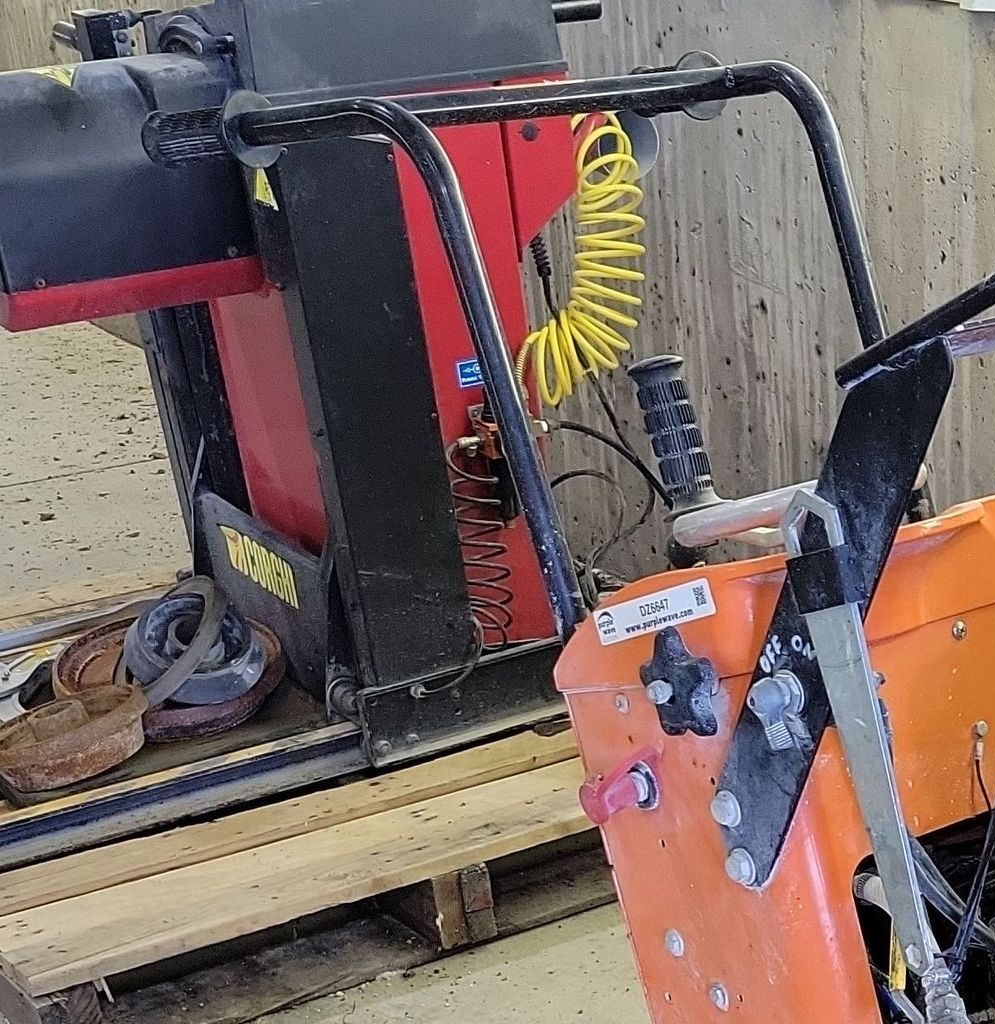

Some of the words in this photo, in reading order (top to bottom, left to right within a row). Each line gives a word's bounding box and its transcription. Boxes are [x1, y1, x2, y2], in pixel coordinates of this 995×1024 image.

[243, 534, 300, 610] CORGHI
[638, 598, 669, 617] DZ6647
[602, 626, 617, 636] wave
[624, 608, 694, 634] www.purplewave.com
[759, 634, 782, 673] OFF
